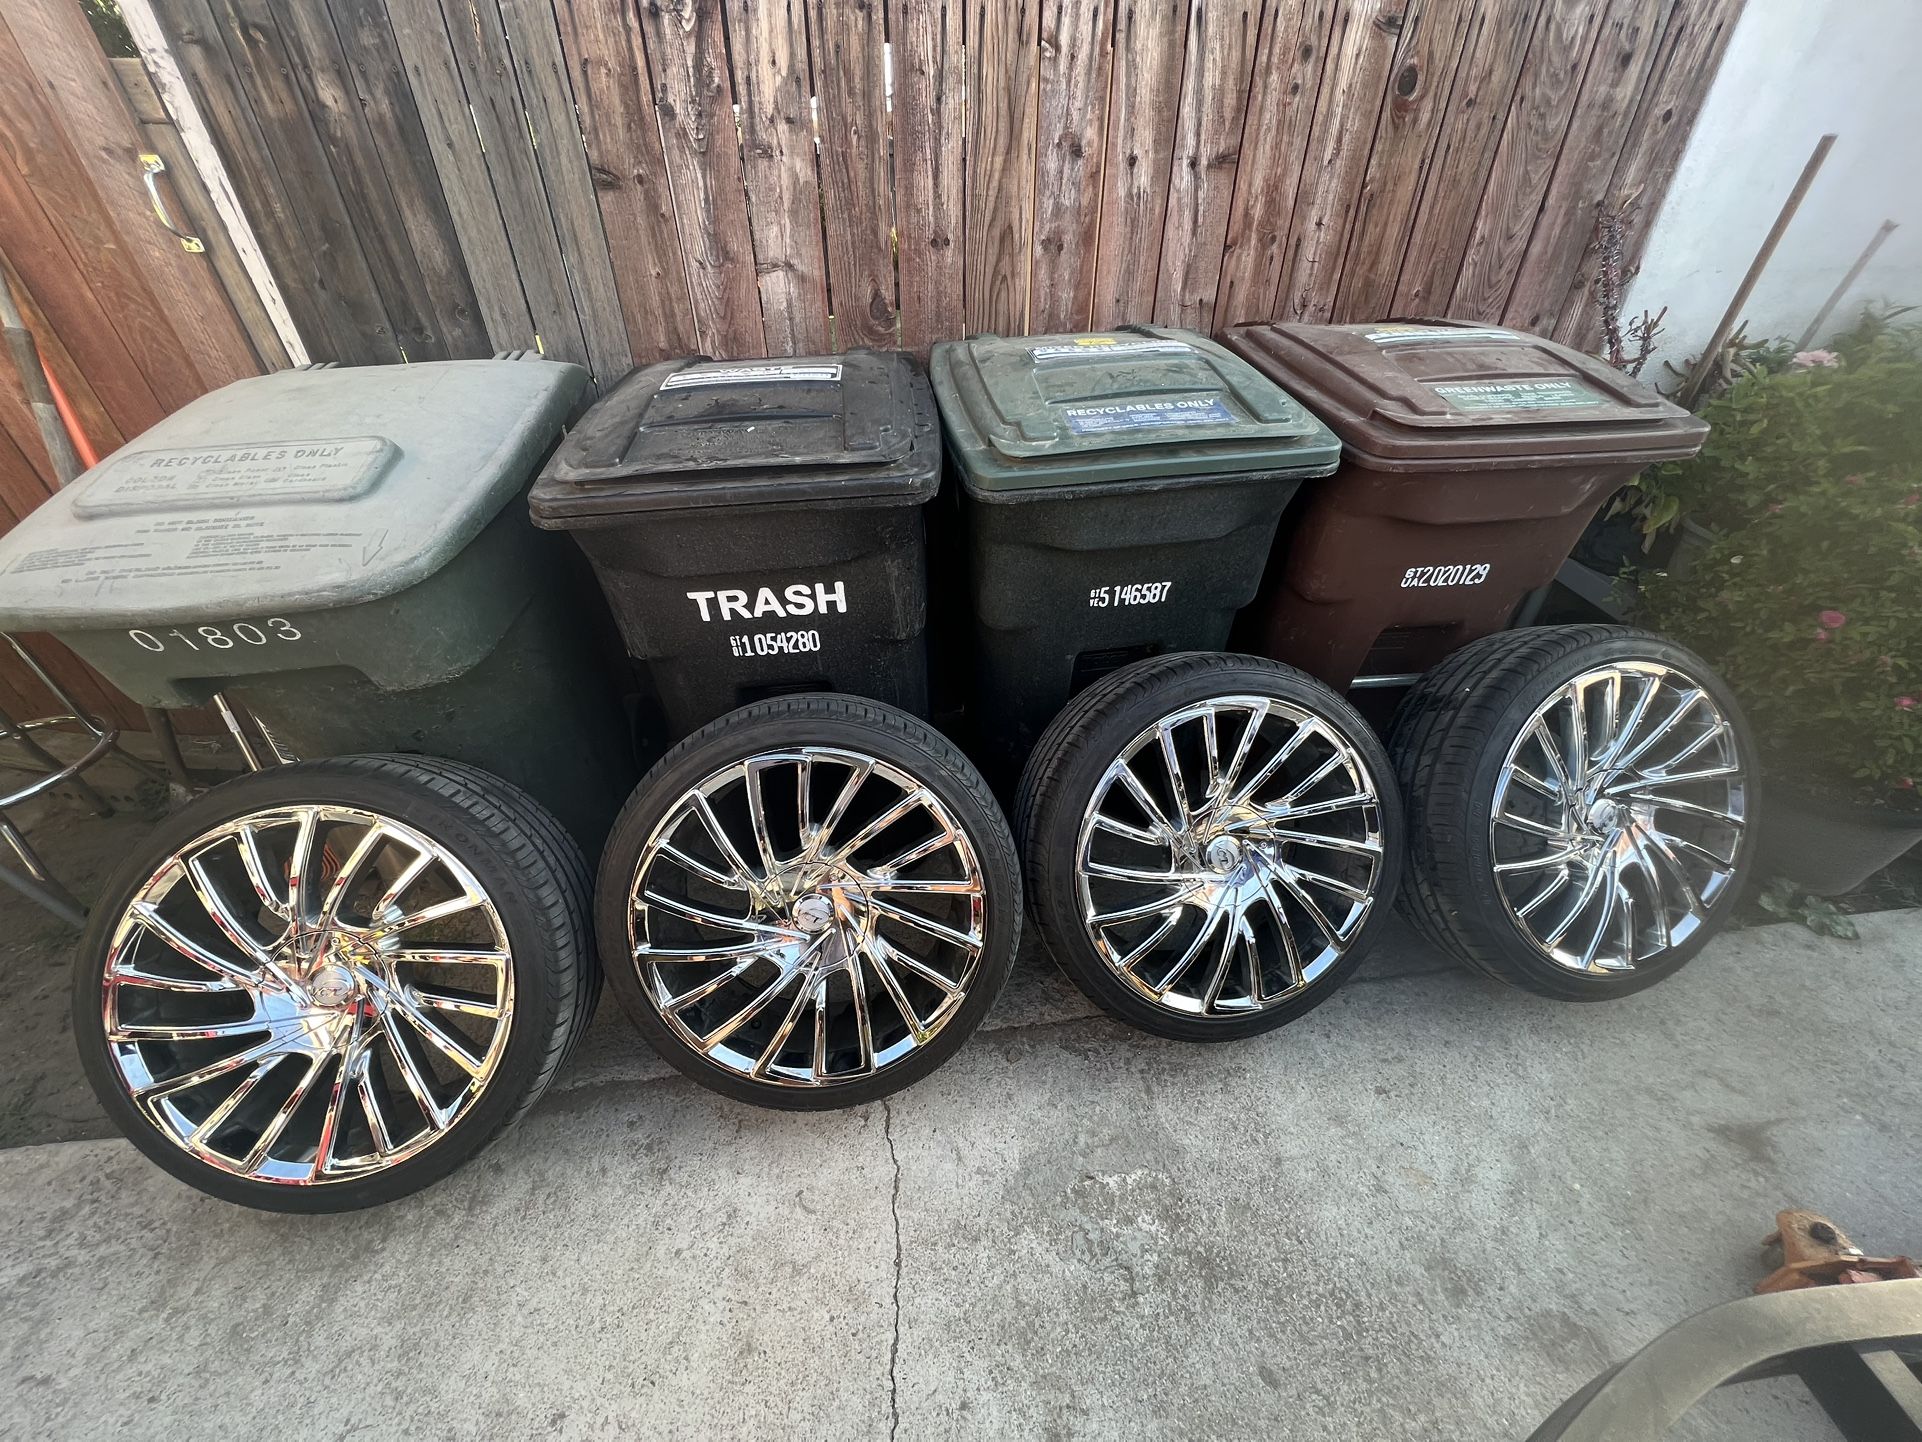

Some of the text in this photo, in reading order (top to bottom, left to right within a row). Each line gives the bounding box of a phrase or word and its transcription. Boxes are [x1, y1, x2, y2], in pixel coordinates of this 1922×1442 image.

[1434, 382, 1572, 395] GREENWASTE ONLY
[1066, 398, 1215, 417] RECYCLABLES ONLY
[150, 446, 345, 468] RECYCLABLES ONLY
[1418, 563, 1491, 587] 2020129
[686, 581, 847, 622] TRASH
[1098, 581, 1172, 608] 5146587
[128, 617, 302, 652] 01803
[741, 629, 821, 657] 1054280
